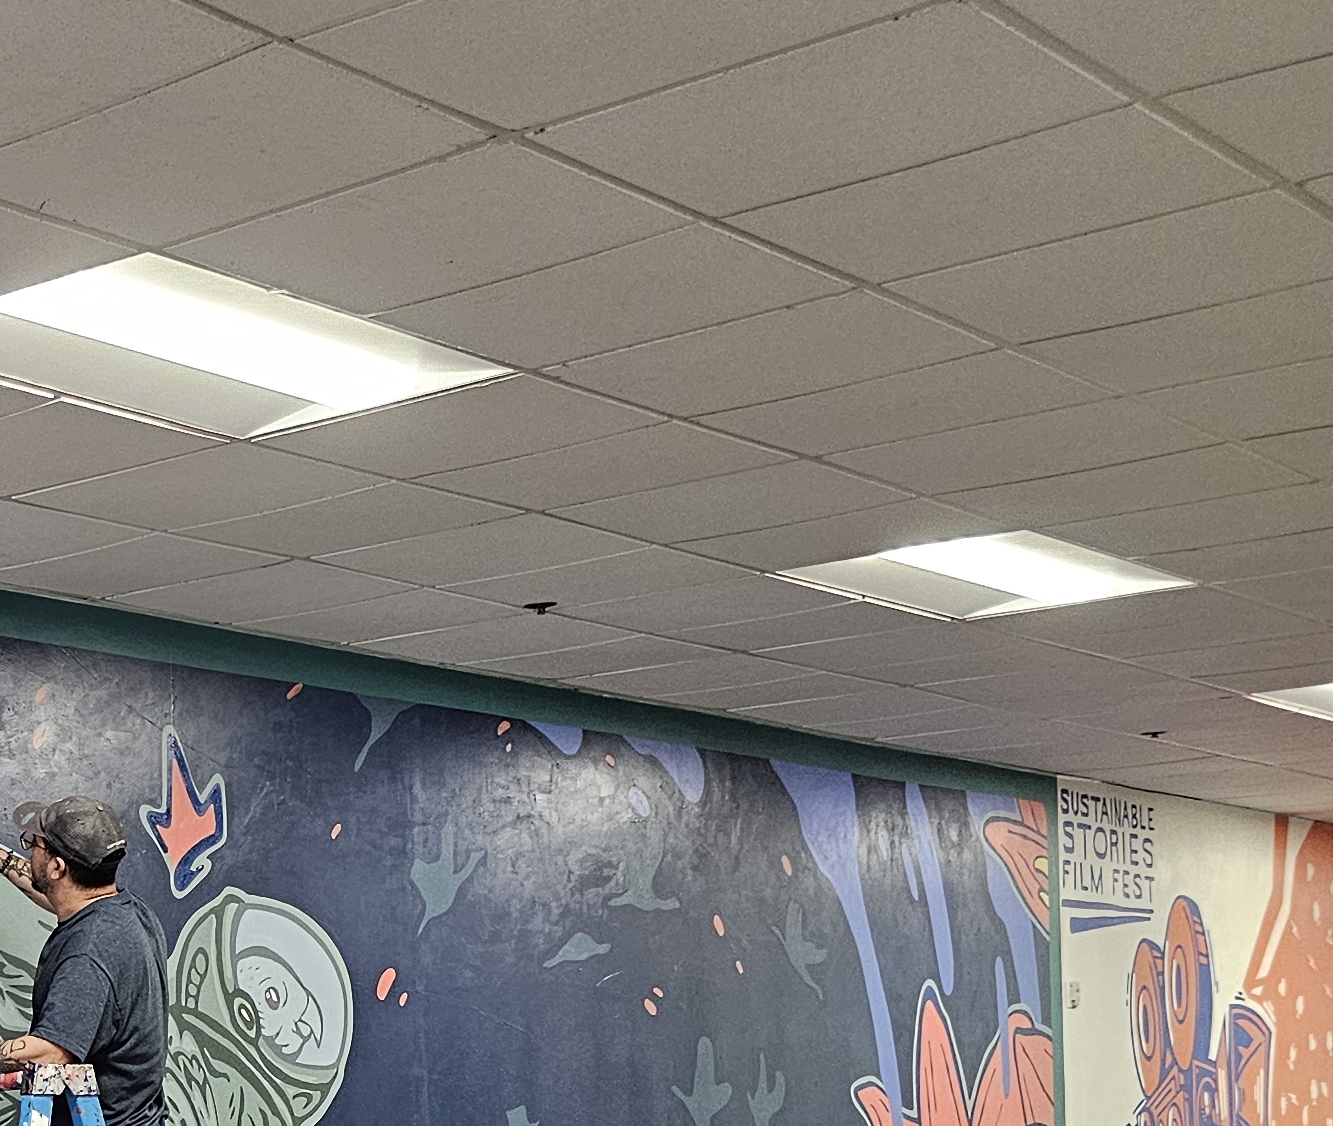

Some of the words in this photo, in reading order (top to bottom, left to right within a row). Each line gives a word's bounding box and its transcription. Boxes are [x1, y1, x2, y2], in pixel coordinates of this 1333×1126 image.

[1060, 788, 1155, 831] SUSTAINABLE
[1062, 820, 1154, 869] STORIES
[1062, 859, 1104, 895] FILM
[1112, 868, 1155, 903] FEST
